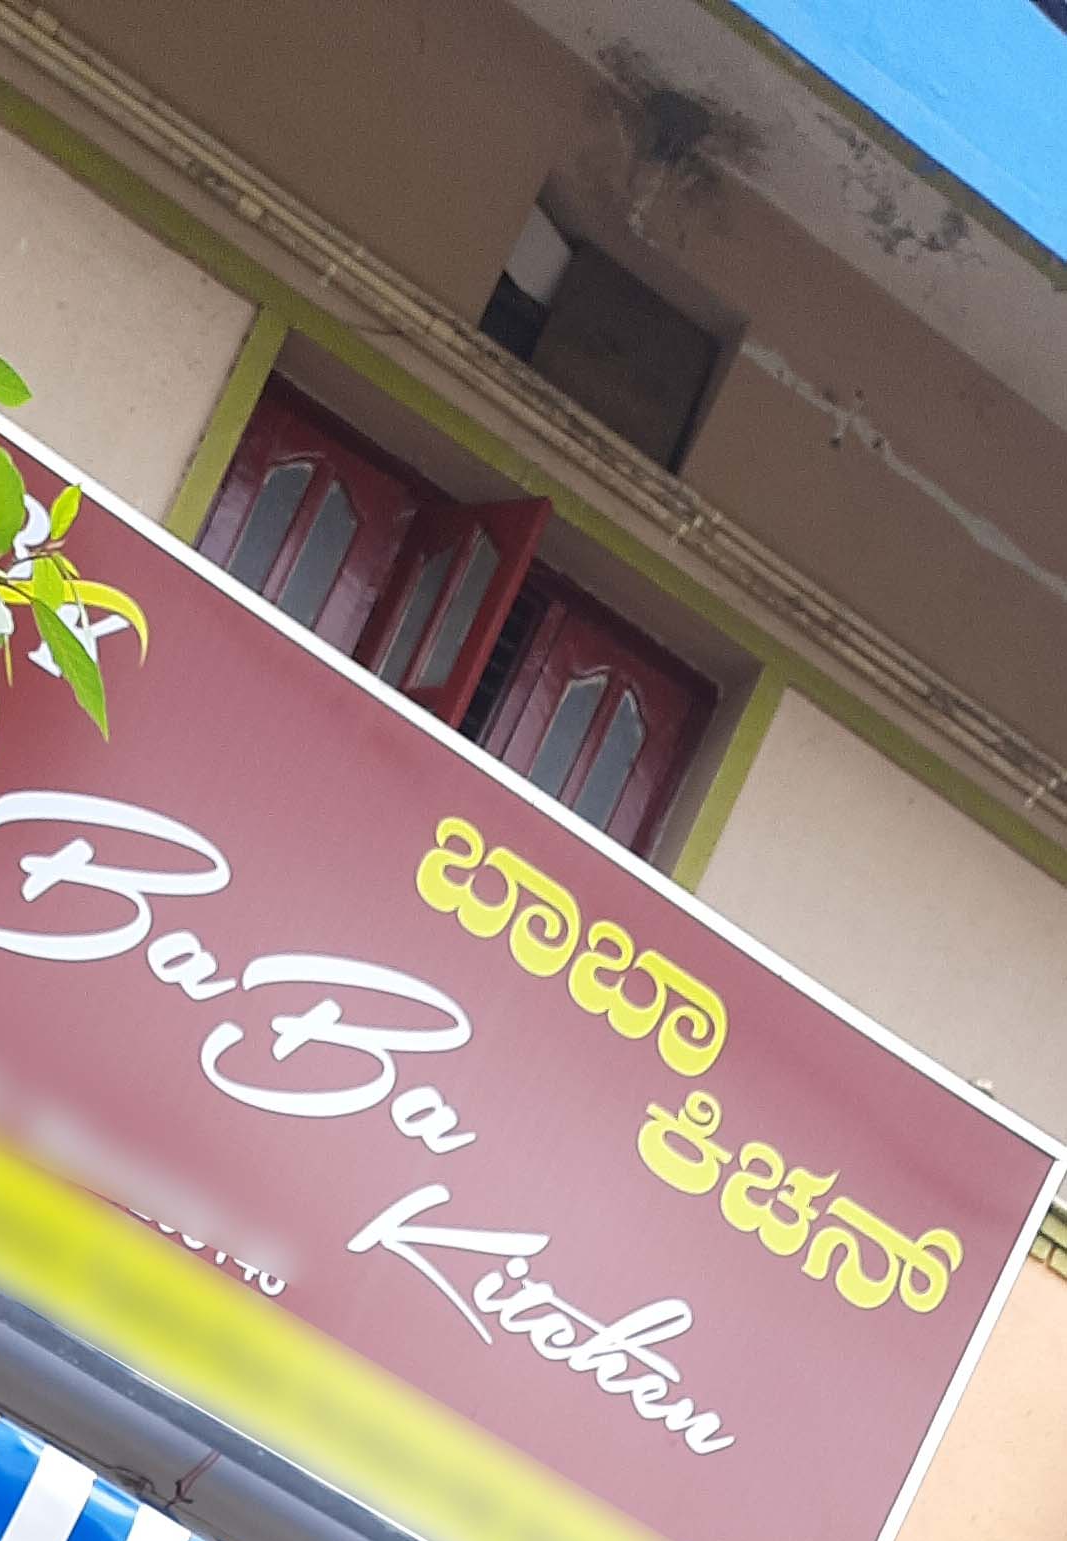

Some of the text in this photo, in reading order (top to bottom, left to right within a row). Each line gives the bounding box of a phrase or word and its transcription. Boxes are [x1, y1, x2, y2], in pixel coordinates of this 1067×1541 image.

[415, 817, 729, 1076] ಬಾಬಾ
[348, 1185, 734, 1456] Kitchen
[638, 1091, 964, 1312] ಕಿಚನ್
